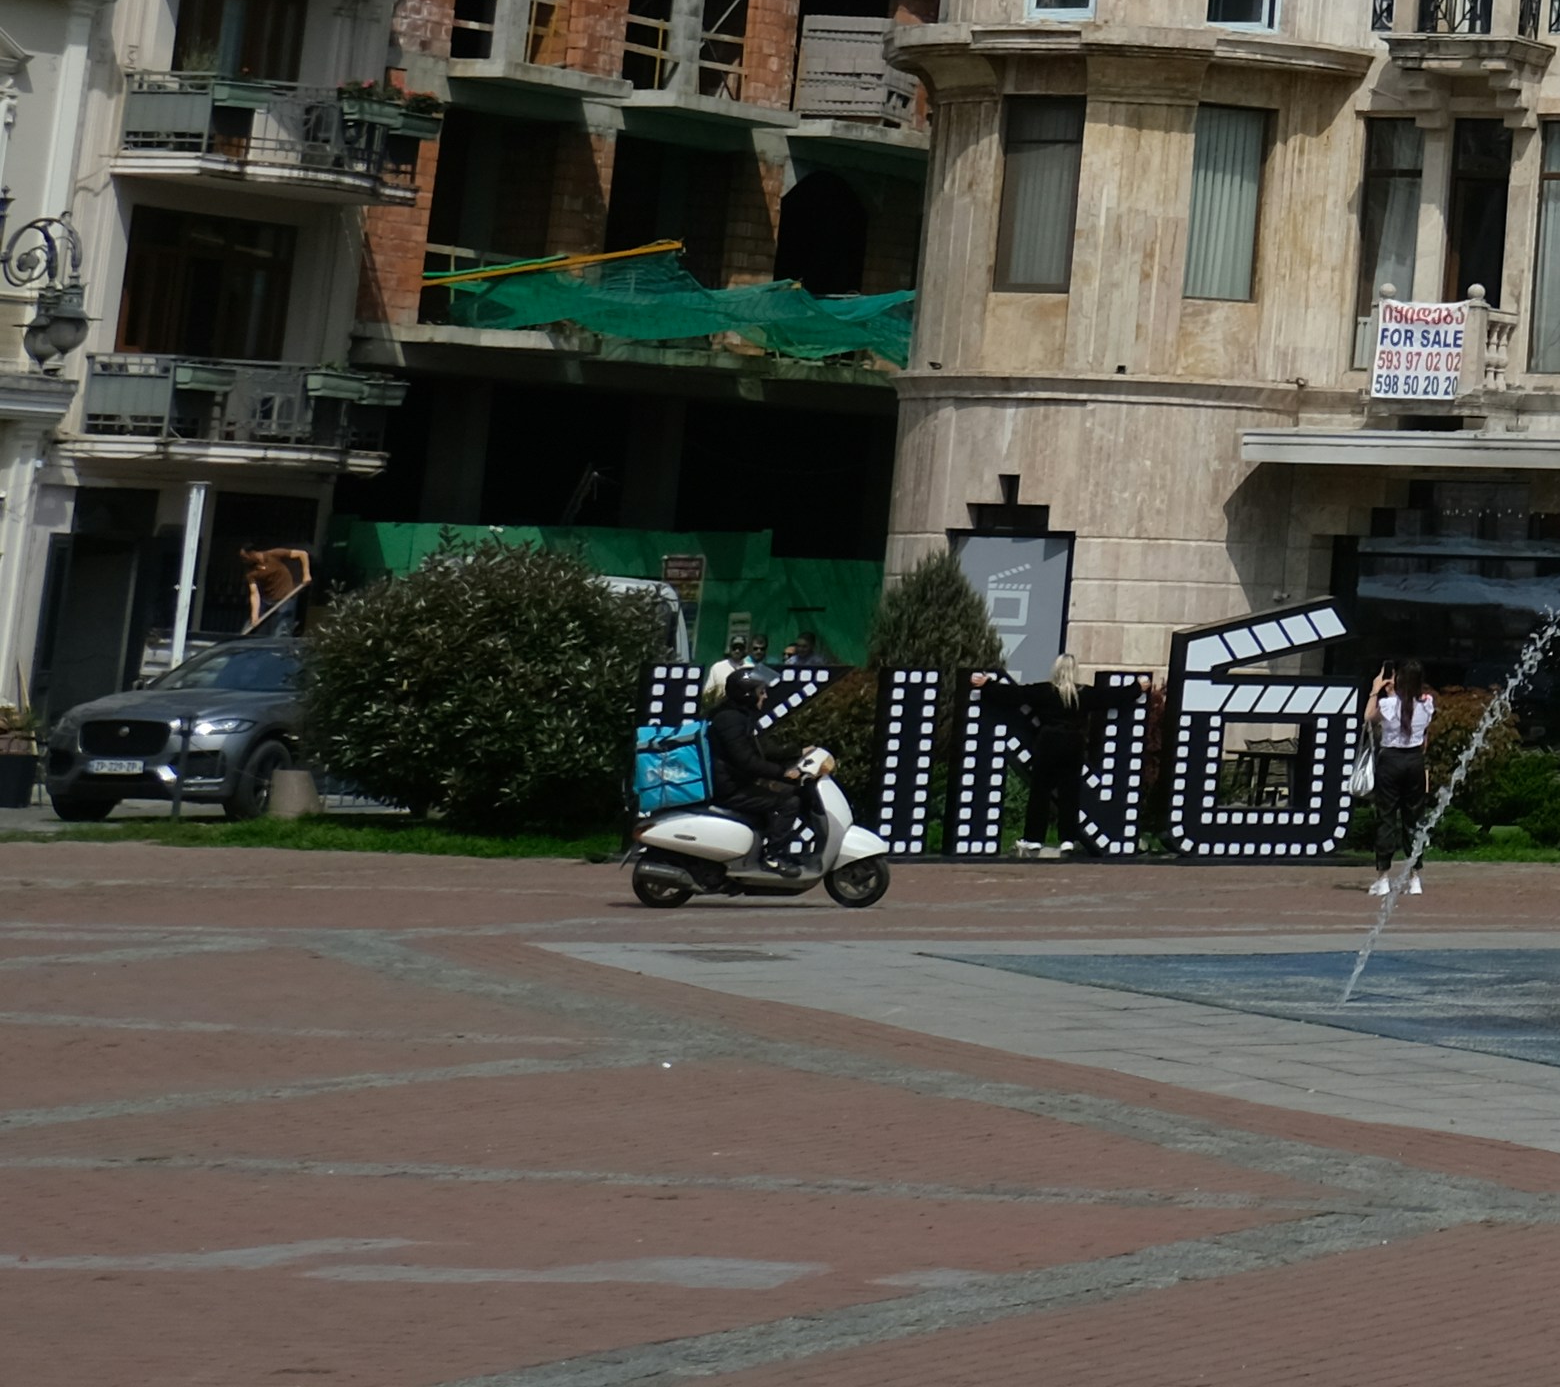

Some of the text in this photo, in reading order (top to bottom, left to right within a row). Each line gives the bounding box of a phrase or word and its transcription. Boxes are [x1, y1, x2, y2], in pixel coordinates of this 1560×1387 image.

[1382, 304, 1466, 325] იყიდება
[1380, 327, 1464, 348] FOR SALE
[1377, 350, 1462, 372] 593 97 02 02
[1374, 374, 1458, 396] 598 50 20 20
